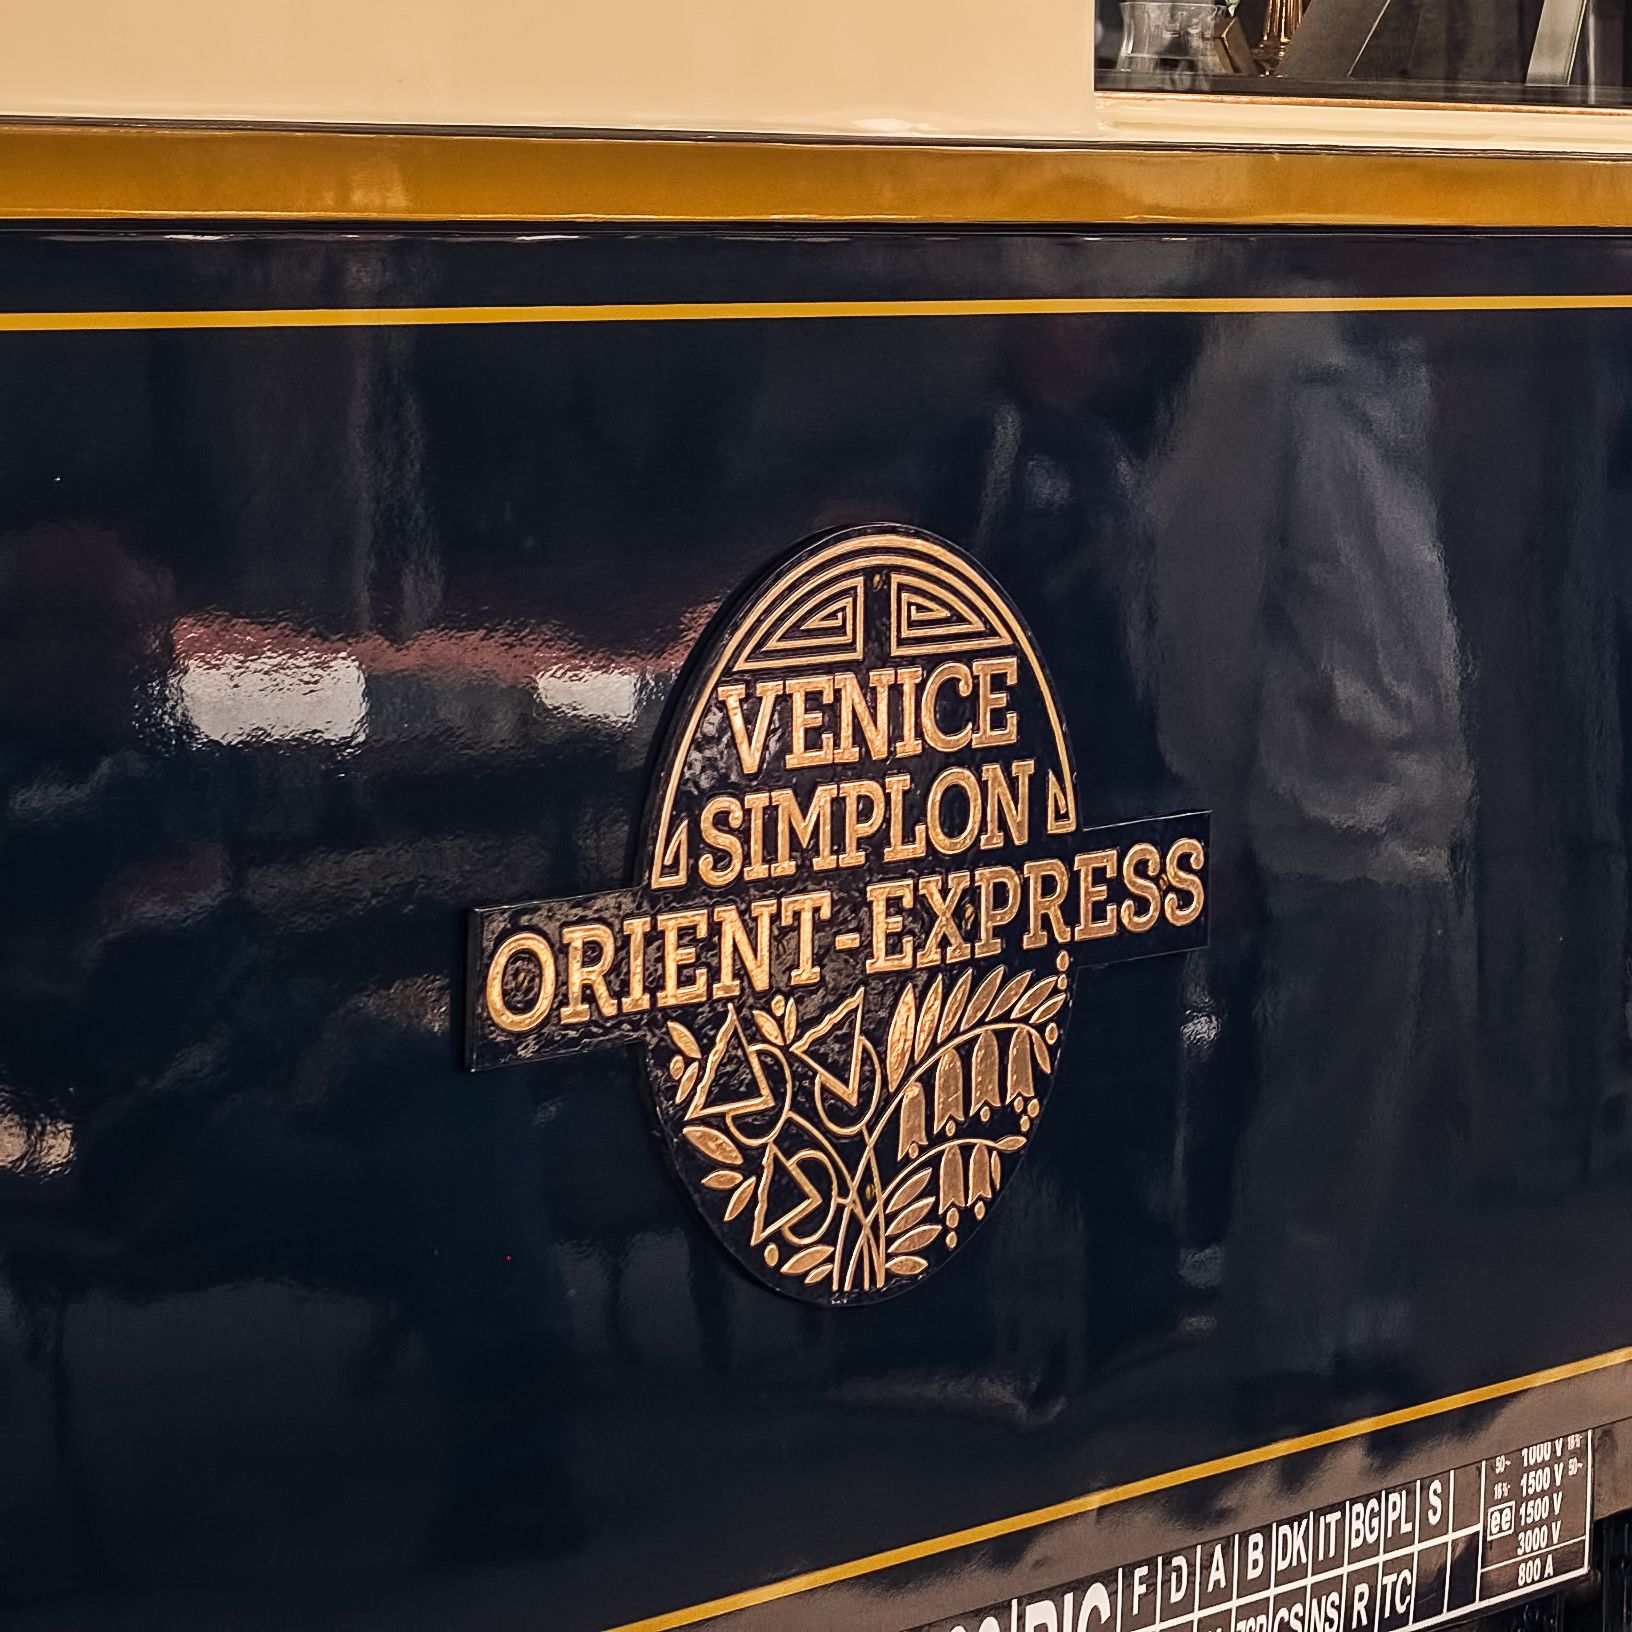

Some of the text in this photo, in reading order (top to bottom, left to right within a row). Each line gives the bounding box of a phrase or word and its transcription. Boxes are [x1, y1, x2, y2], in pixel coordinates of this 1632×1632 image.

[718, 658, 1018, 774] VENICE
[698, 760, 1034, 886] SIMPLON
[484, 838, 1205, 1032] ORIENT-EXPRESS
[1522, 1442, 1551, 1467] 1000
[1554, 1439, 1563, 1457] V
[1520, 1466, 1550, 1497] 1500
[1554, 1462, 1564, 1486] V
[1520, 1496, 1549, 1526] 1500
[1553, 1492, 1562, 1515] V
[1132, 1565, 1148, 1615] F
[1170, 1555, 1188, 1603] D
[1207, 1543, 1226, 1592] A
[1247, 1532, 1264, 1580] B
[1277, 1518, 1308, 1571] DK
[1318, 1510, 1341, 1561] IT
[1351, 1498, 1379, 1549] BG
[1387, 1489, 1412, 1538] PL
[1428, 1479, 1442, 1525] S
[1517, 1520, 1561, 1556] 3000 V
[1518, 1554, 1554, 1587] 800 A
[1352, 1582, 1369, 1629] R
[1381, 1569, 1412, 1618] TC
